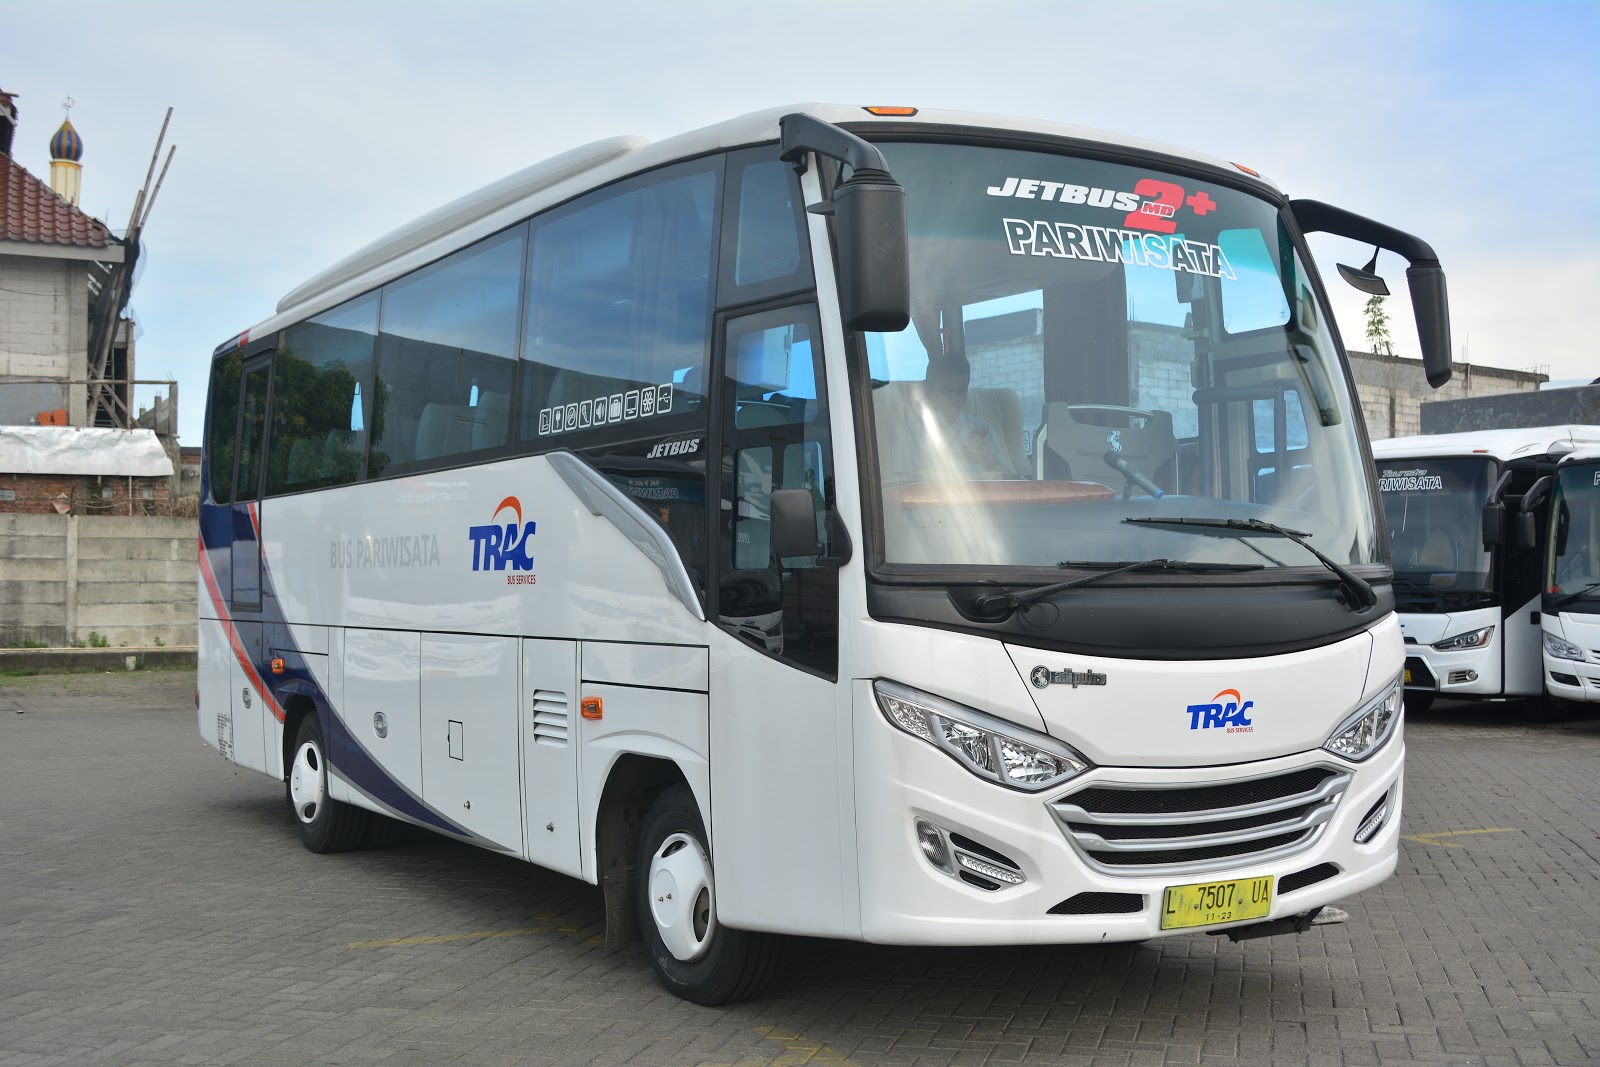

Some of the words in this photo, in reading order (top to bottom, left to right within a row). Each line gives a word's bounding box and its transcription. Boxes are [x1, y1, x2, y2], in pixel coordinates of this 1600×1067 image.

[987, 177, 1140, 211] JETBUS
[1003, 217, 1238, 281] PARIWISATA
[646, 438, 700, 459] JETBUS
[330, 541, 352, 569] BUS
[357, 534, 440, 568] PARIWISATA
[469, 521, 537, 572] TRAC
[507, 574, 516, 585] BUS
[516, 574, 537, 585] SERVICES
[1186, 700, 1254, 730] TRAC
[1166, 890, 1176, 915] L
[1198, 883, 1236, 911] 7507
[1252, 880, 1269, 903] UA
[1206, 911, 1232, 921] 11-23
